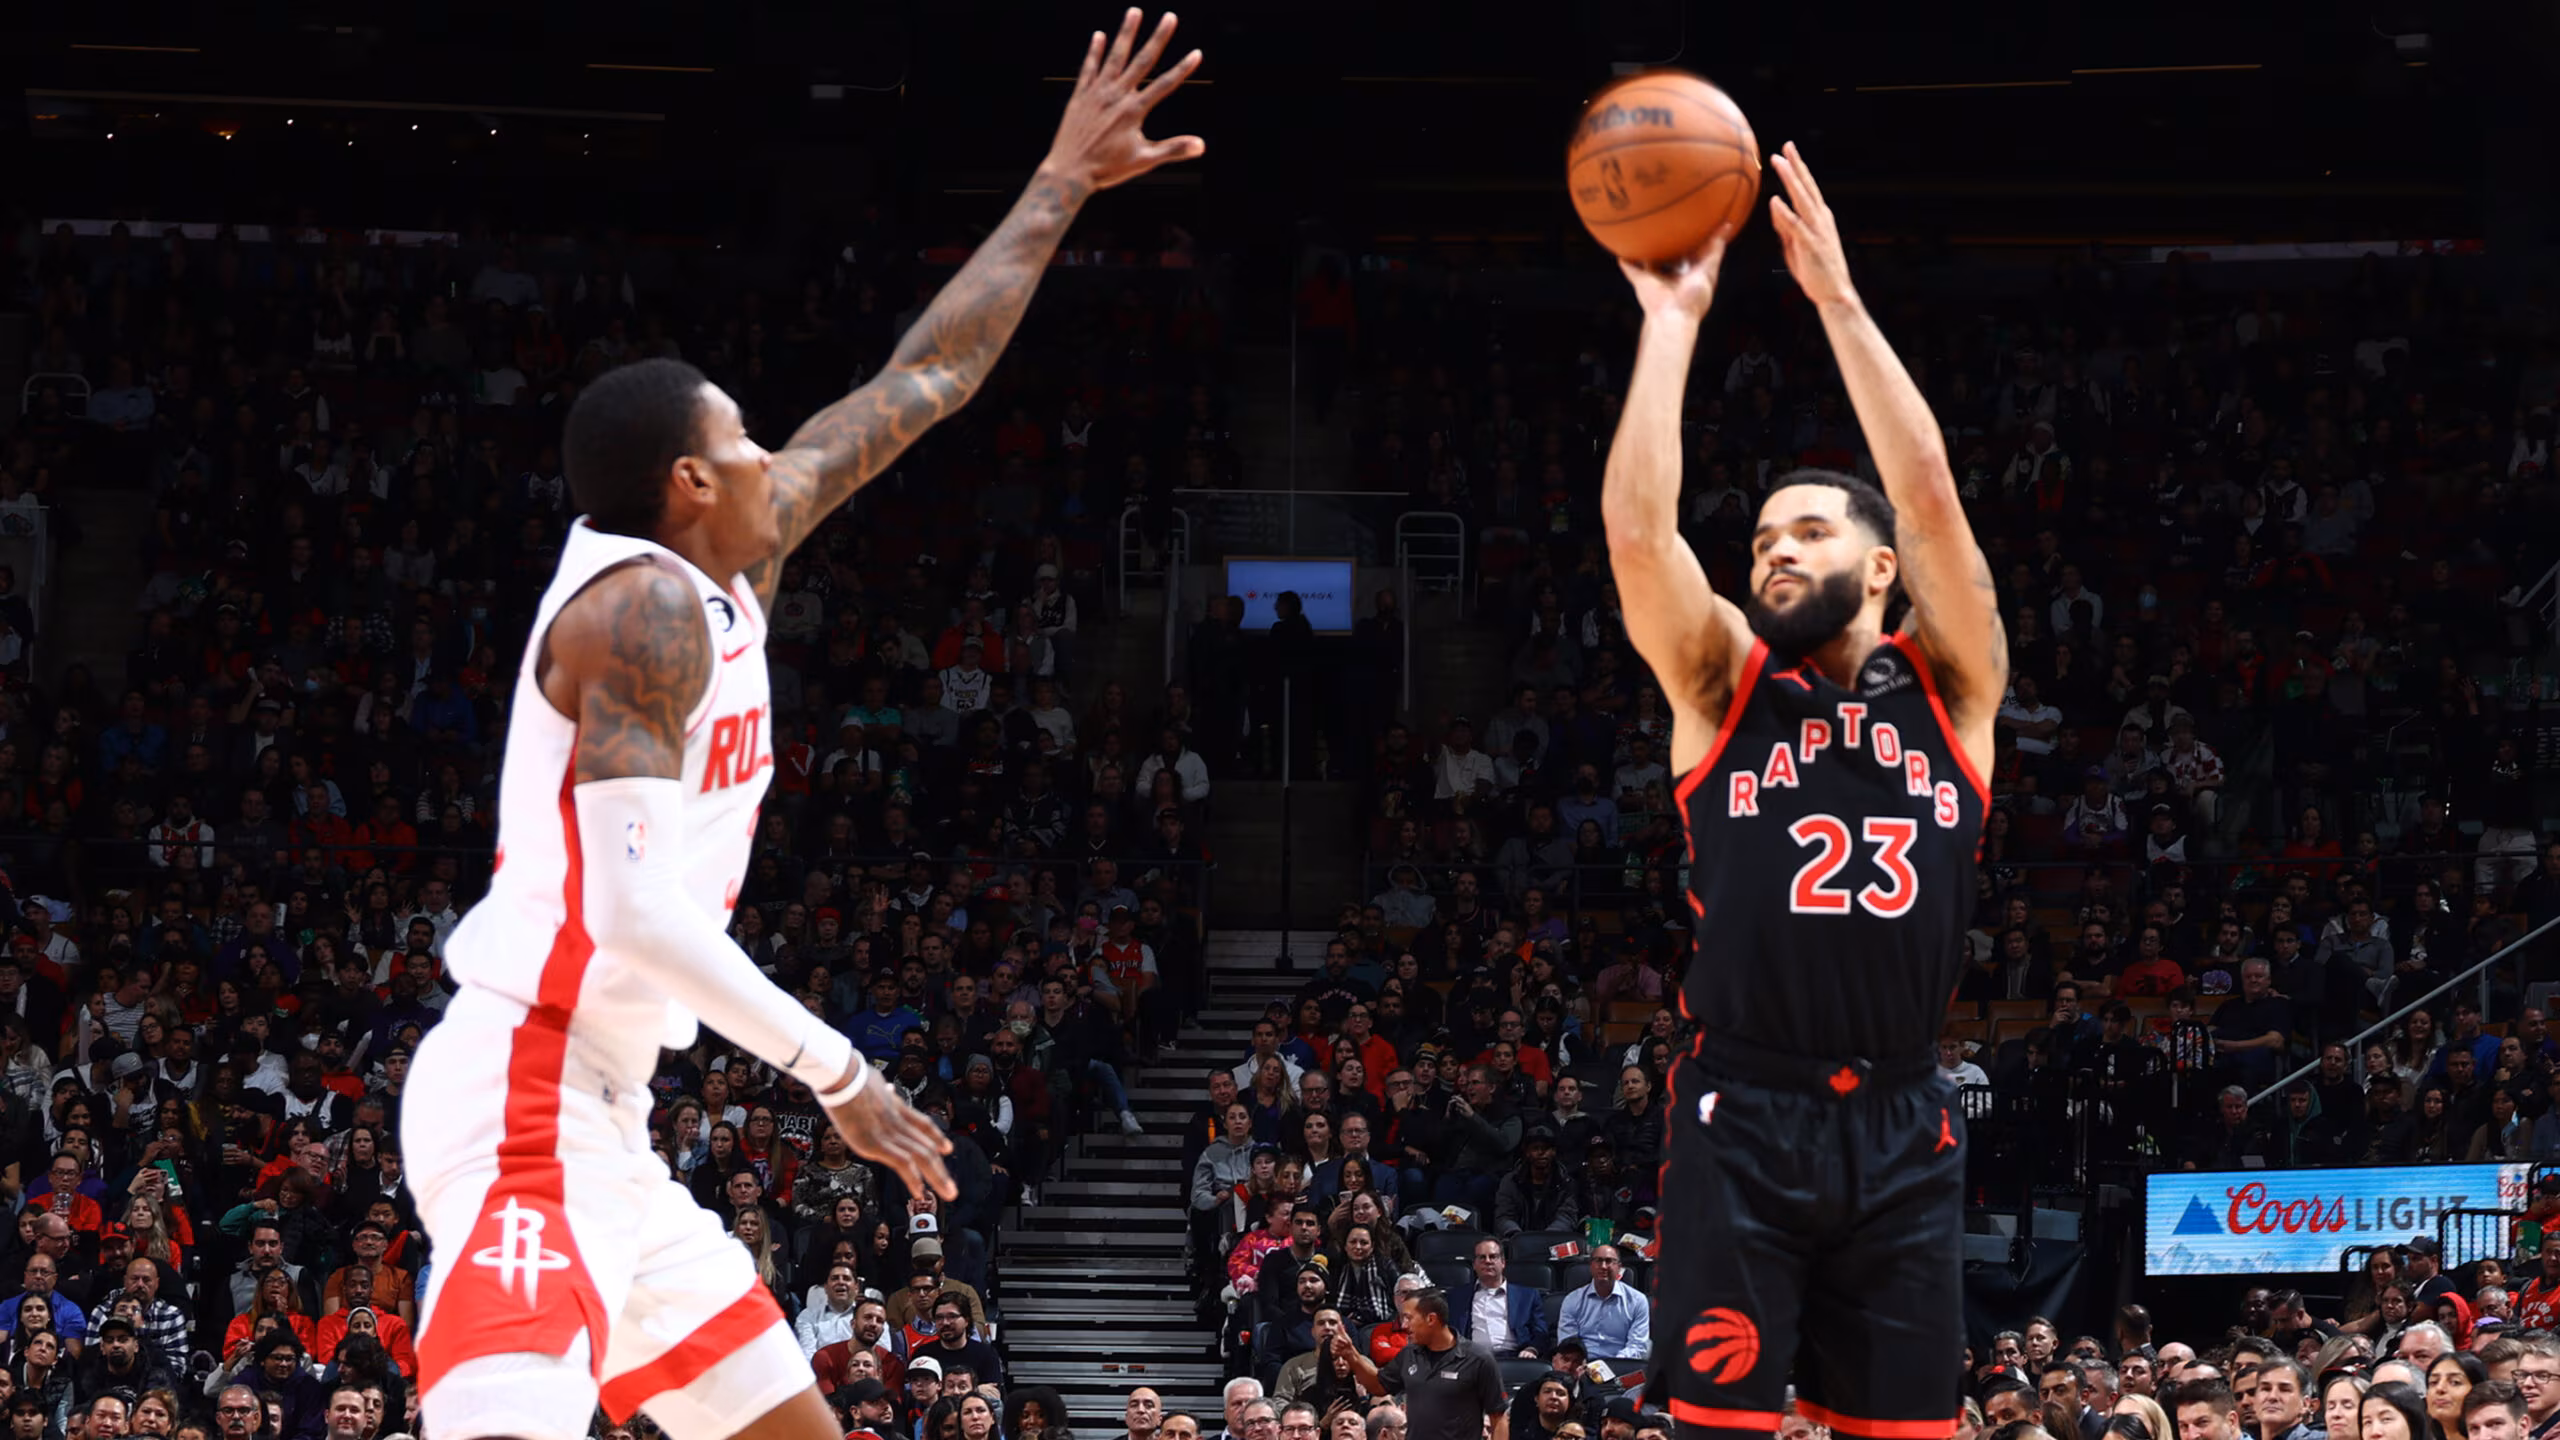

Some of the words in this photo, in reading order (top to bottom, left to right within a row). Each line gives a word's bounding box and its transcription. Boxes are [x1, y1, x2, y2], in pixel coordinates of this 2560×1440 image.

[1729, 702, 1959, 828] RAPTORS
[1788, 813, 1919, 918] 23
[2226, 1181, 2349, 1234] Coors
[2354, 1195, 2470, 1232] LIGHT
